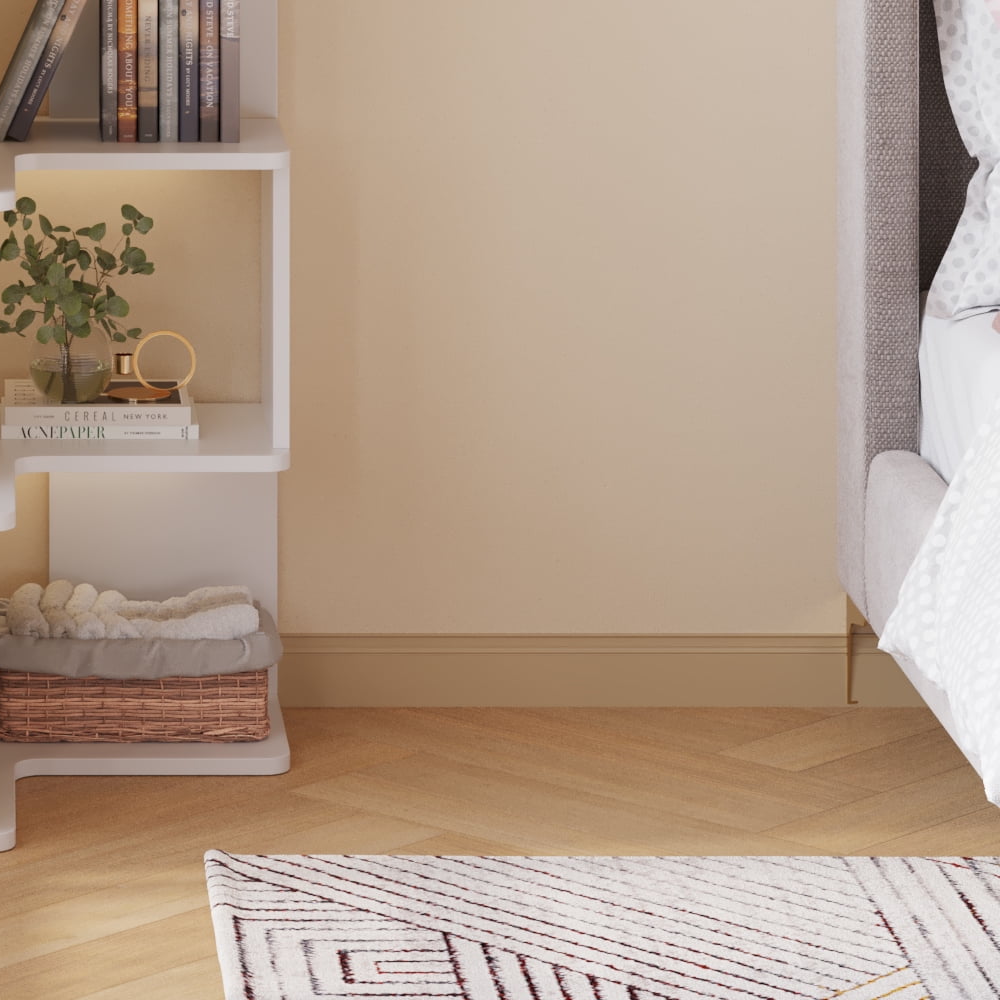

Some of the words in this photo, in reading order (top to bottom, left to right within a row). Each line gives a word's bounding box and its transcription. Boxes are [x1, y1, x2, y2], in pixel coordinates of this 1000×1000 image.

[106, 23, 112, 32] BY
[144, 15, 152, 45] NEVER
[226, 10, 234, 38] STEVE
[185, 31, 193, 65] NIGHTS
[206, 45, 213, 59] ON
[125, 51, 133, 83] ABOUT
[144, 46, 152, 83] ENDING
[125, 85, 133, 107] YOU
[64, 410, 117, 422] CEREAL
